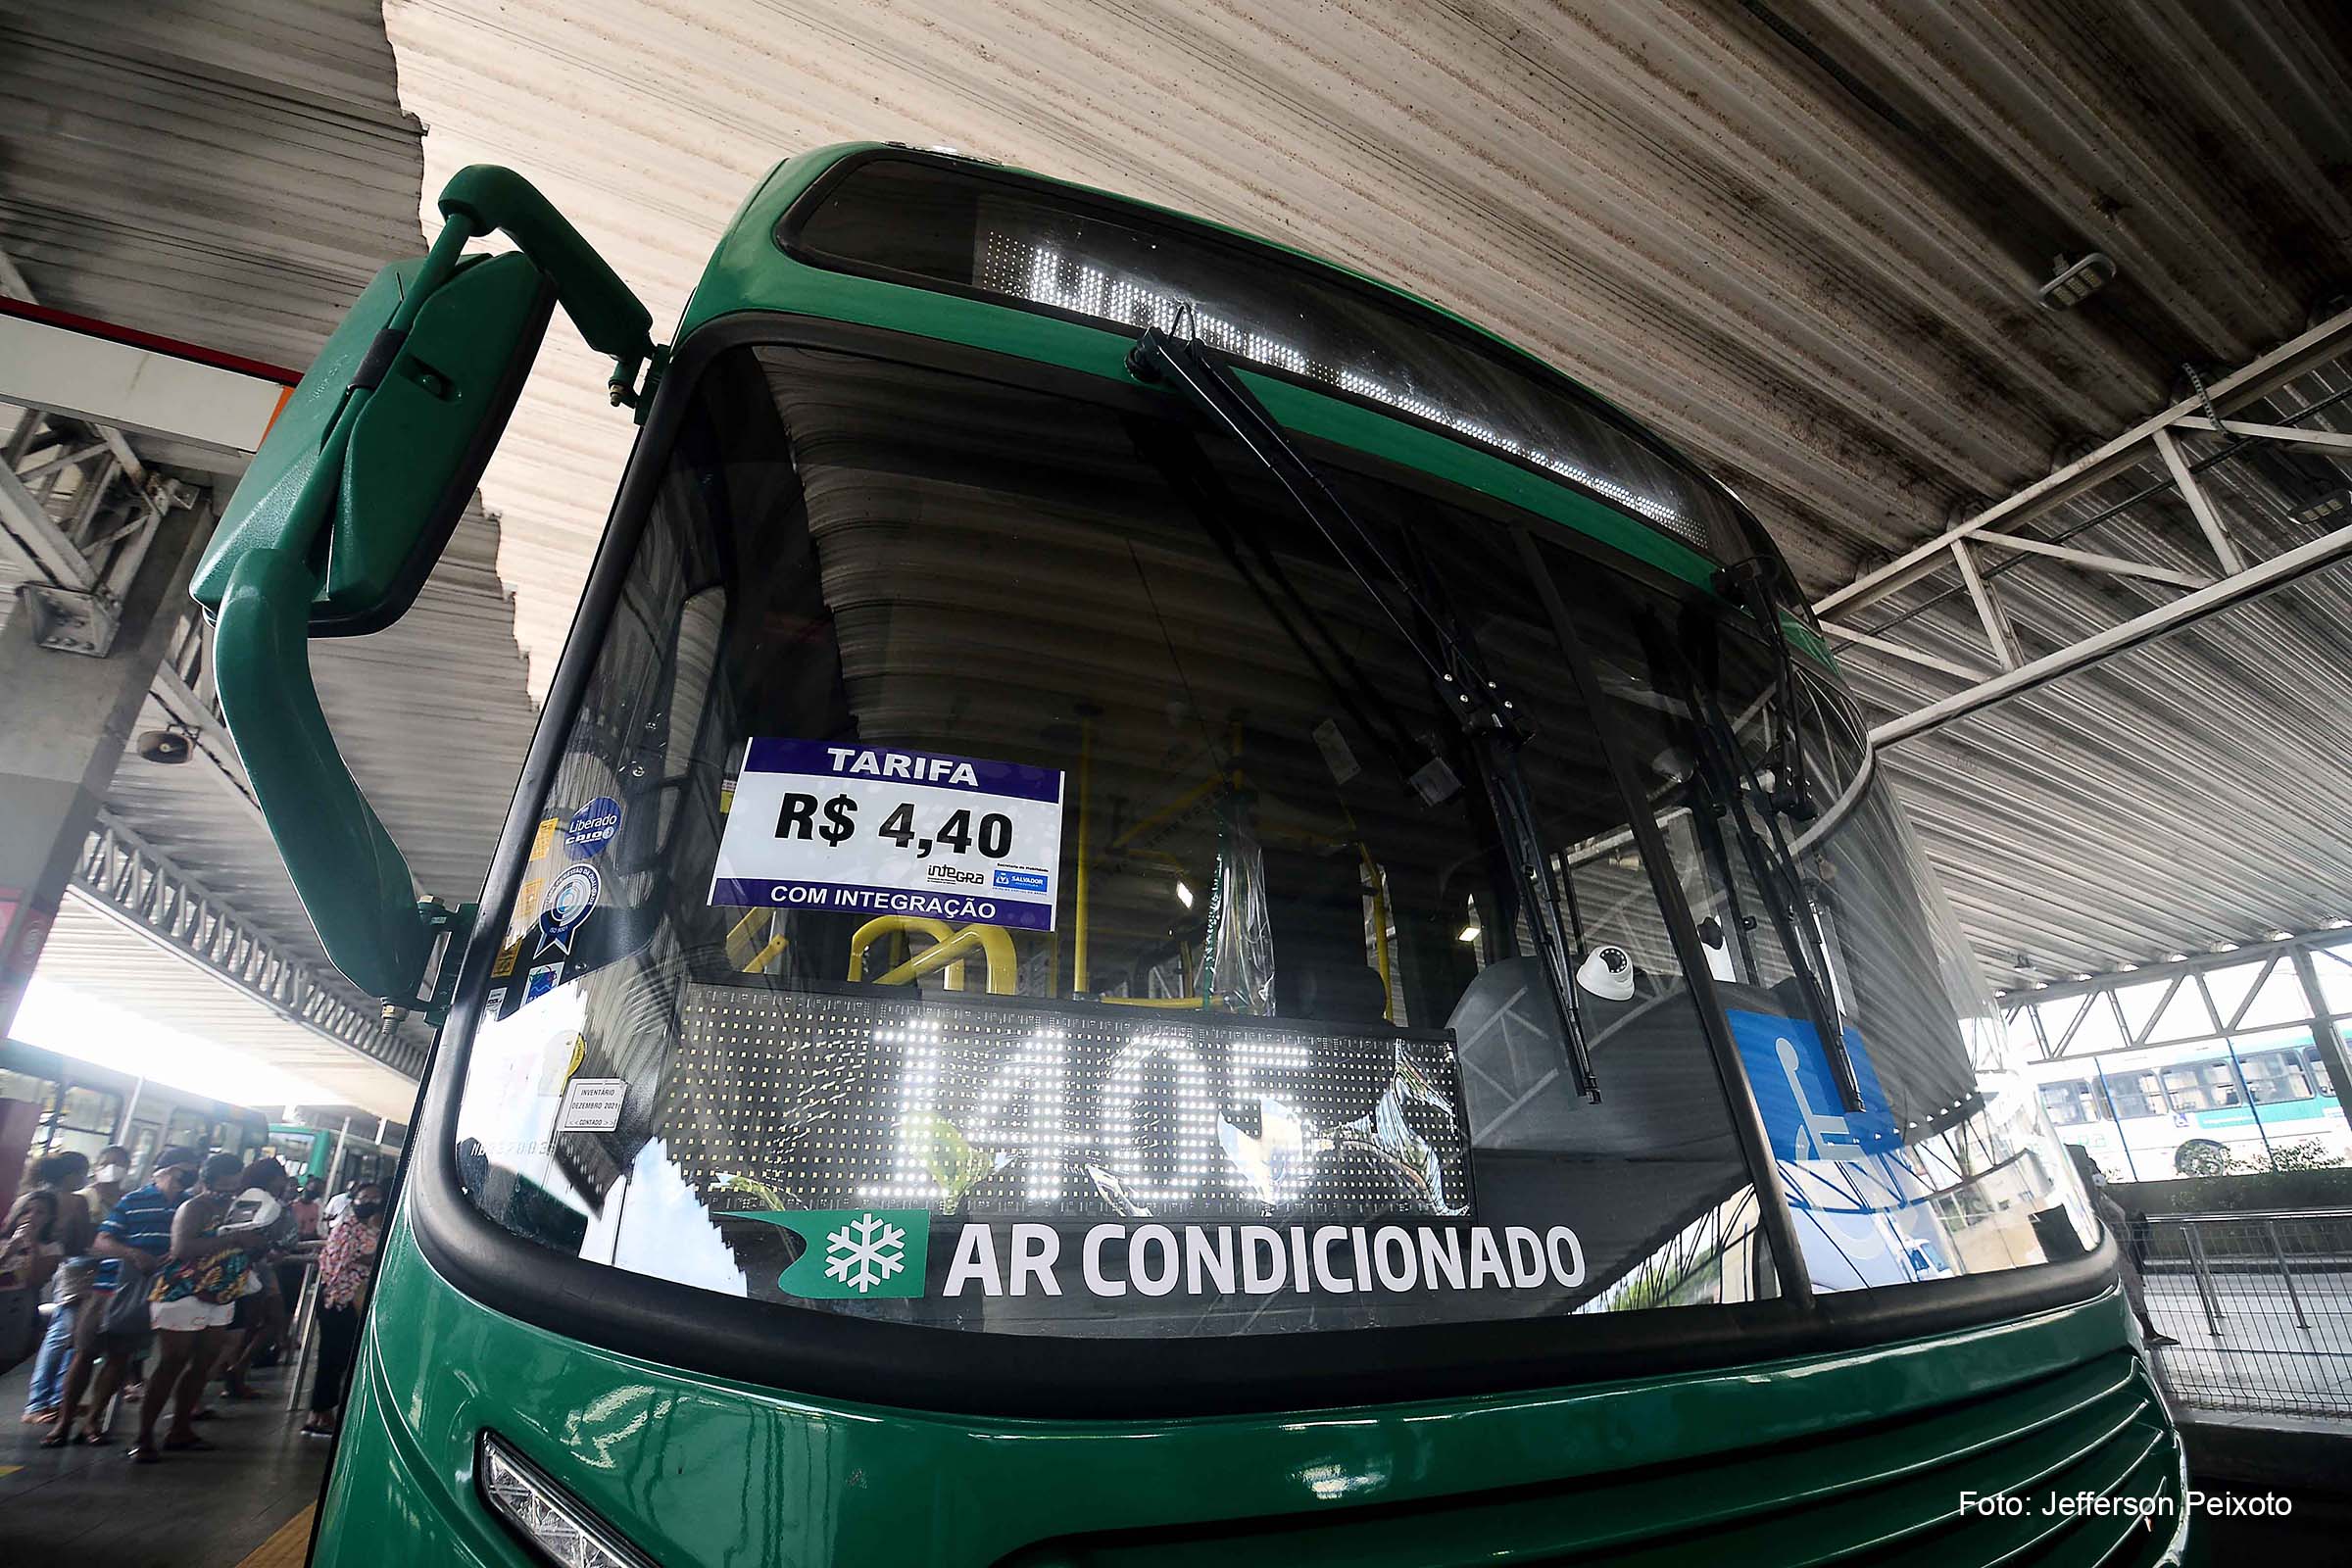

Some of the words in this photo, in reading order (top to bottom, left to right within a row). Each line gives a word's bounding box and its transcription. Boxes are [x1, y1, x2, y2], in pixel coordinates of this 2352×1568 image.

[827, 748, 978, 787] TARIFA
[568, 813, 617, 833] Liberado
[774, 791, 859, 848] R$
[877, 802, 1014, 858] 4,40
[1011, 875, 1043, 885] SALVADOR
[770, 885, 827, 905] COM
[834, 889, 997, 919] INTEGRAÇÃO
[580, 1088, 615, 1097] INVENTÁRIO
[857, 1020, 1317, 1201] 1405
[943, 1223, 1063, 1298] AR
[1084, 1223, 1586, 1297] CONDICIONADO
